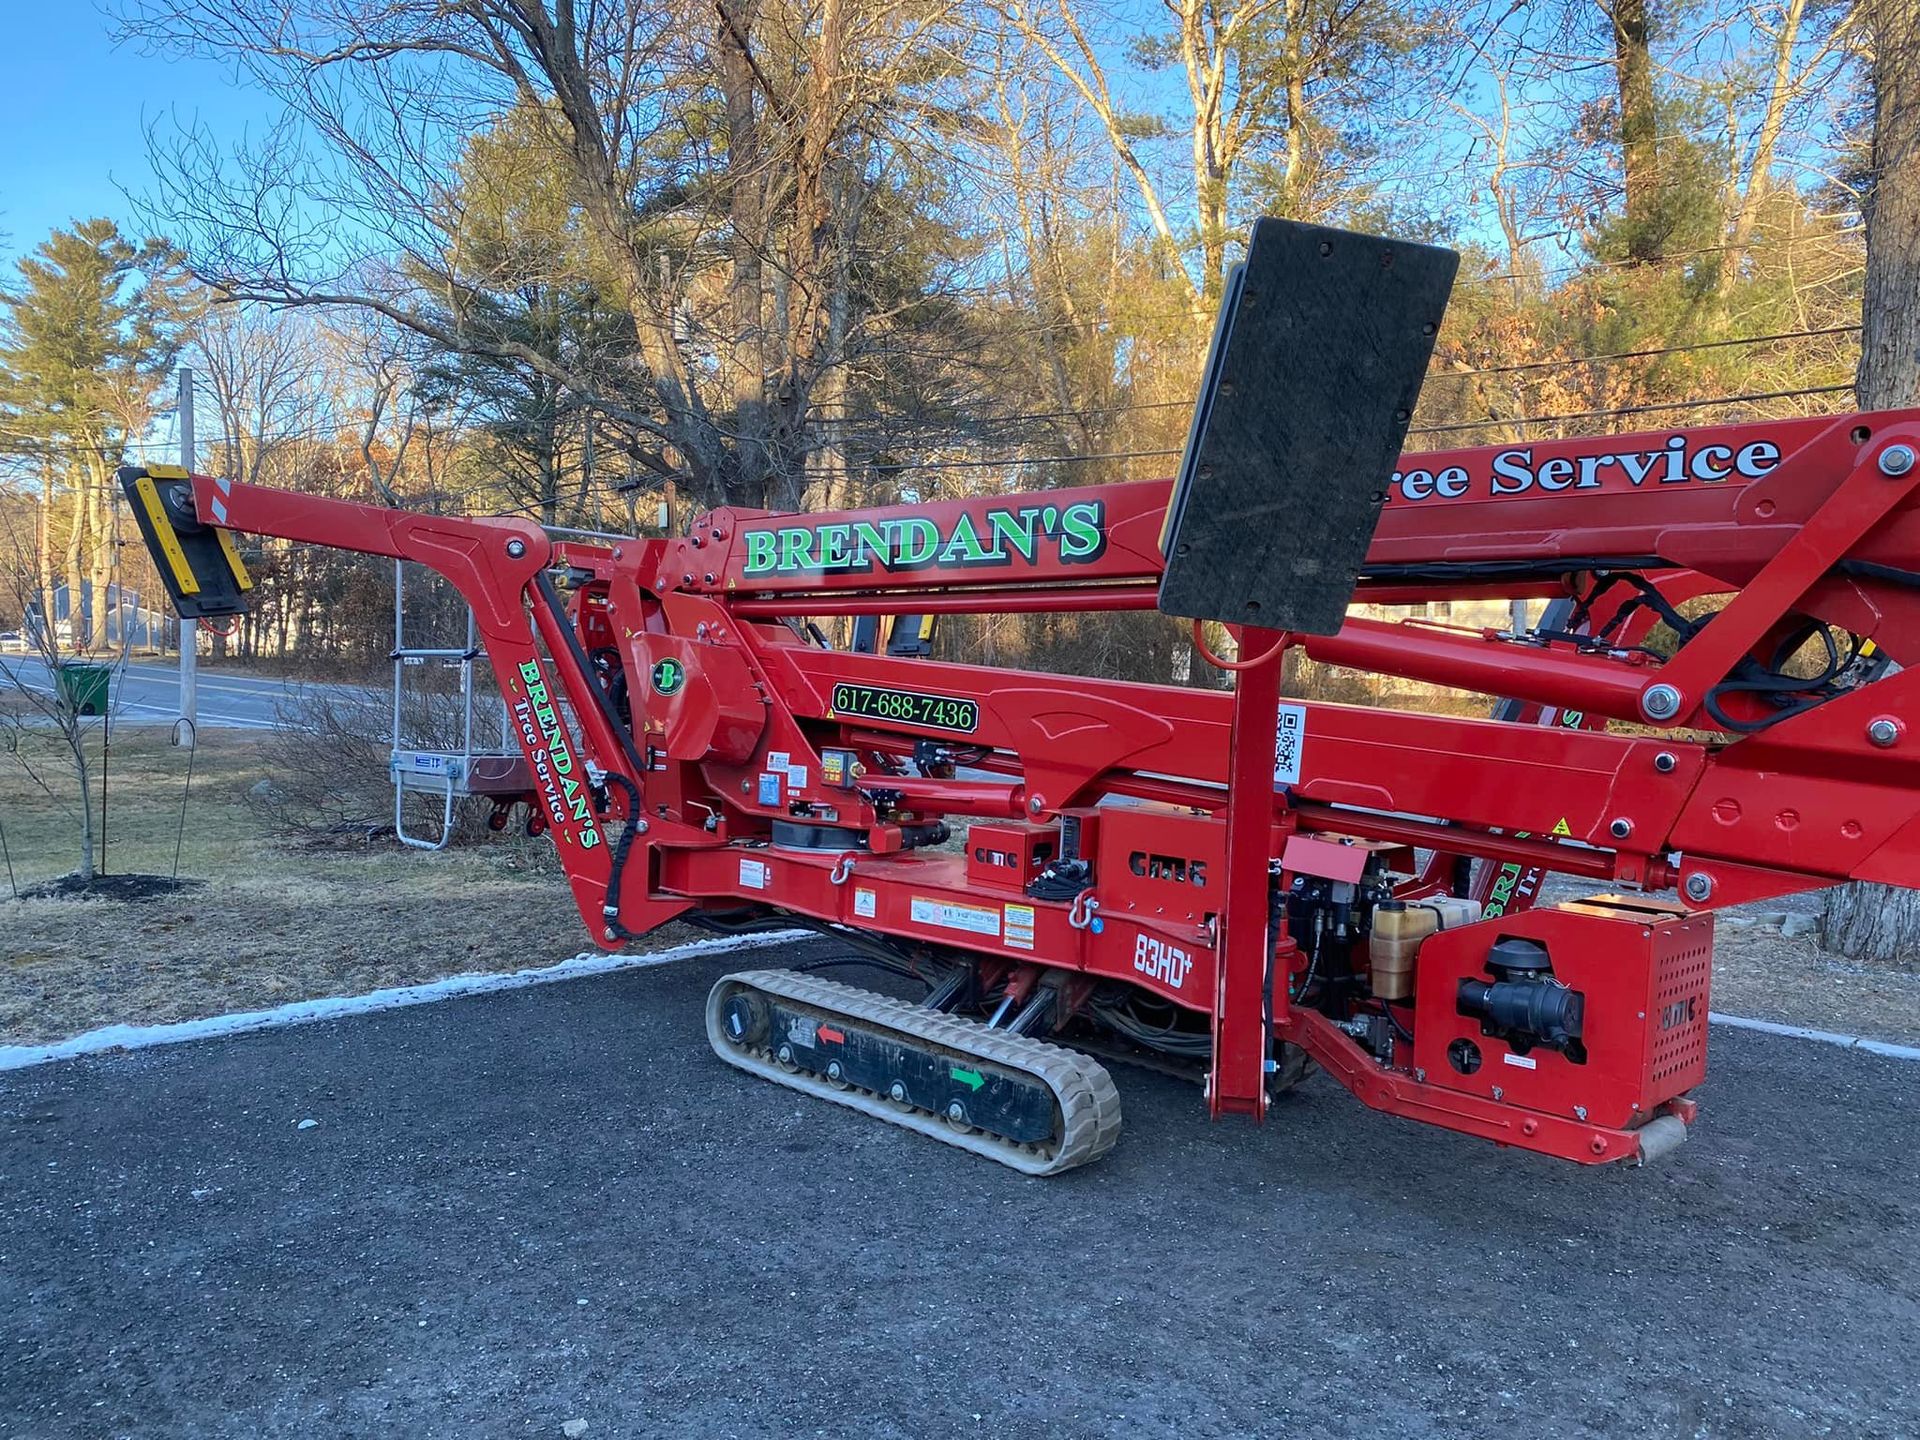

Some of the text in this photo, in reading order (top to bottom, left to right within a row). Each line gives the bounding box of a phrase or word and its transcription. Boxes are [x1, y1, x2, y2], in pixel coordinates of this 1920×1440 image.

[1490, 435, 1782, 496] Service
[743, 501, 1103, 576] BRENDAN'S
[836, 687, 972, 730] 617-688-7436
[513, 696, 565, 824] Tree Service
[517, 658, 600, 850] BRENDAN'S
